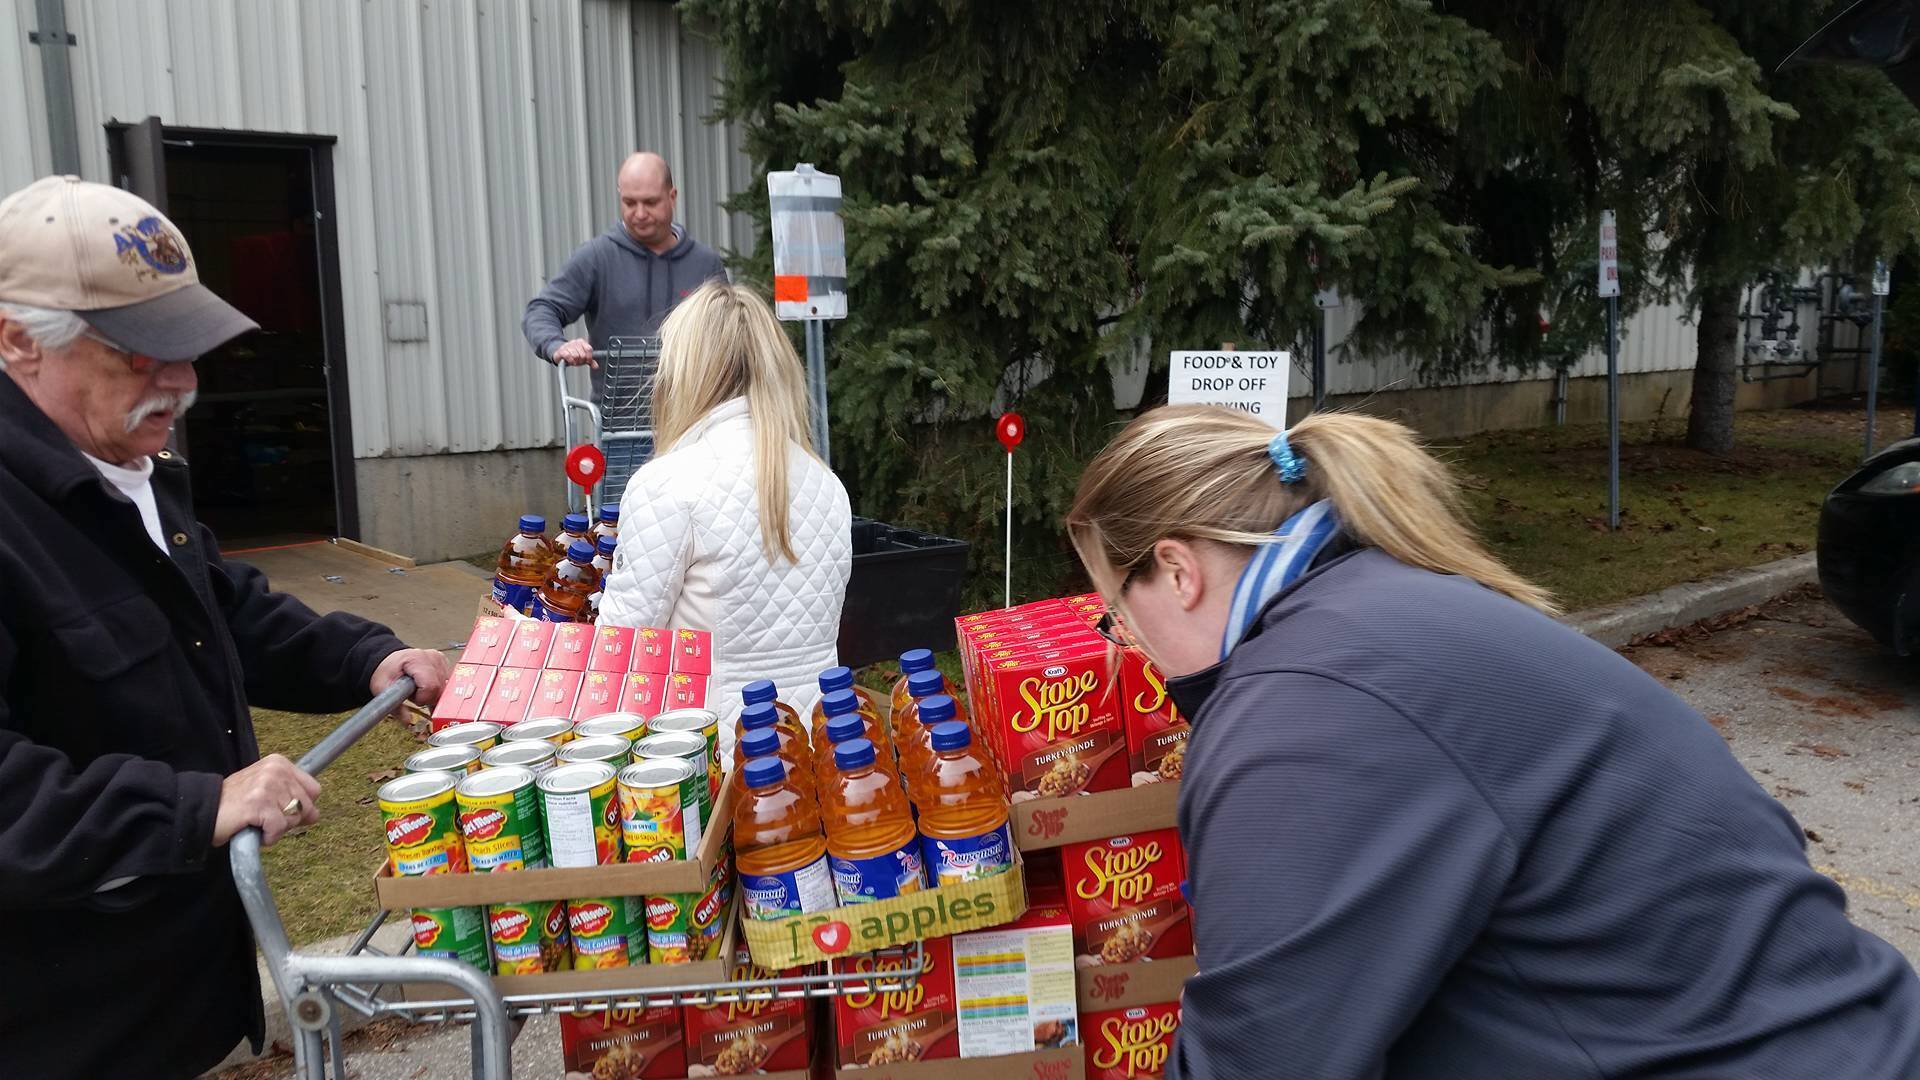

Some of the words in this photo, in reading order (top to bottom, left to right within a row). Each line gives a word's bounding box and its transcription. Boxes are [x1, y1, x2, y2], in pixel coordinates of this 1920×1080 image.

[1184, 356, 1226, 369] FOOD
[1231, 356, 1242, 369] &
[1248, 356, 1278, 368] TOY
[1192, 378, 1234, 391] DROP
[1238, 378, 1266, 390] OFF
[1195, 402, 1262, 414] KING
[1011, 670, 1098, 733] Stove
[1047, 702, 1090, 742] Top
[1156, 730, 1187, 747] TURKEY
[1035, 750, 1066, 766] TURKEY
[1068, 739, 1095, 754] DINDE
[387, 826, 404, 842] Del
[400, 815, 432, 834] Monte
[473, 811, 504, 829] Monte
[1076, 841, 1162, 899] Stove
[1112, 872, 1153, 910] Top
[498, 914, 528, 930] Monte
[579, 906, 610, 923] Monte
[650, 902, 676, 915] Monte
[697, 899, 715, 923] Del
[786, 920, 804, 962] I
[861, 893, 995, 942] apples
[880, 982, 924, 1020] Top
[1093, 1012, 1177, 1068] Stove
[1127, 1042, 1168, 1079] Top
